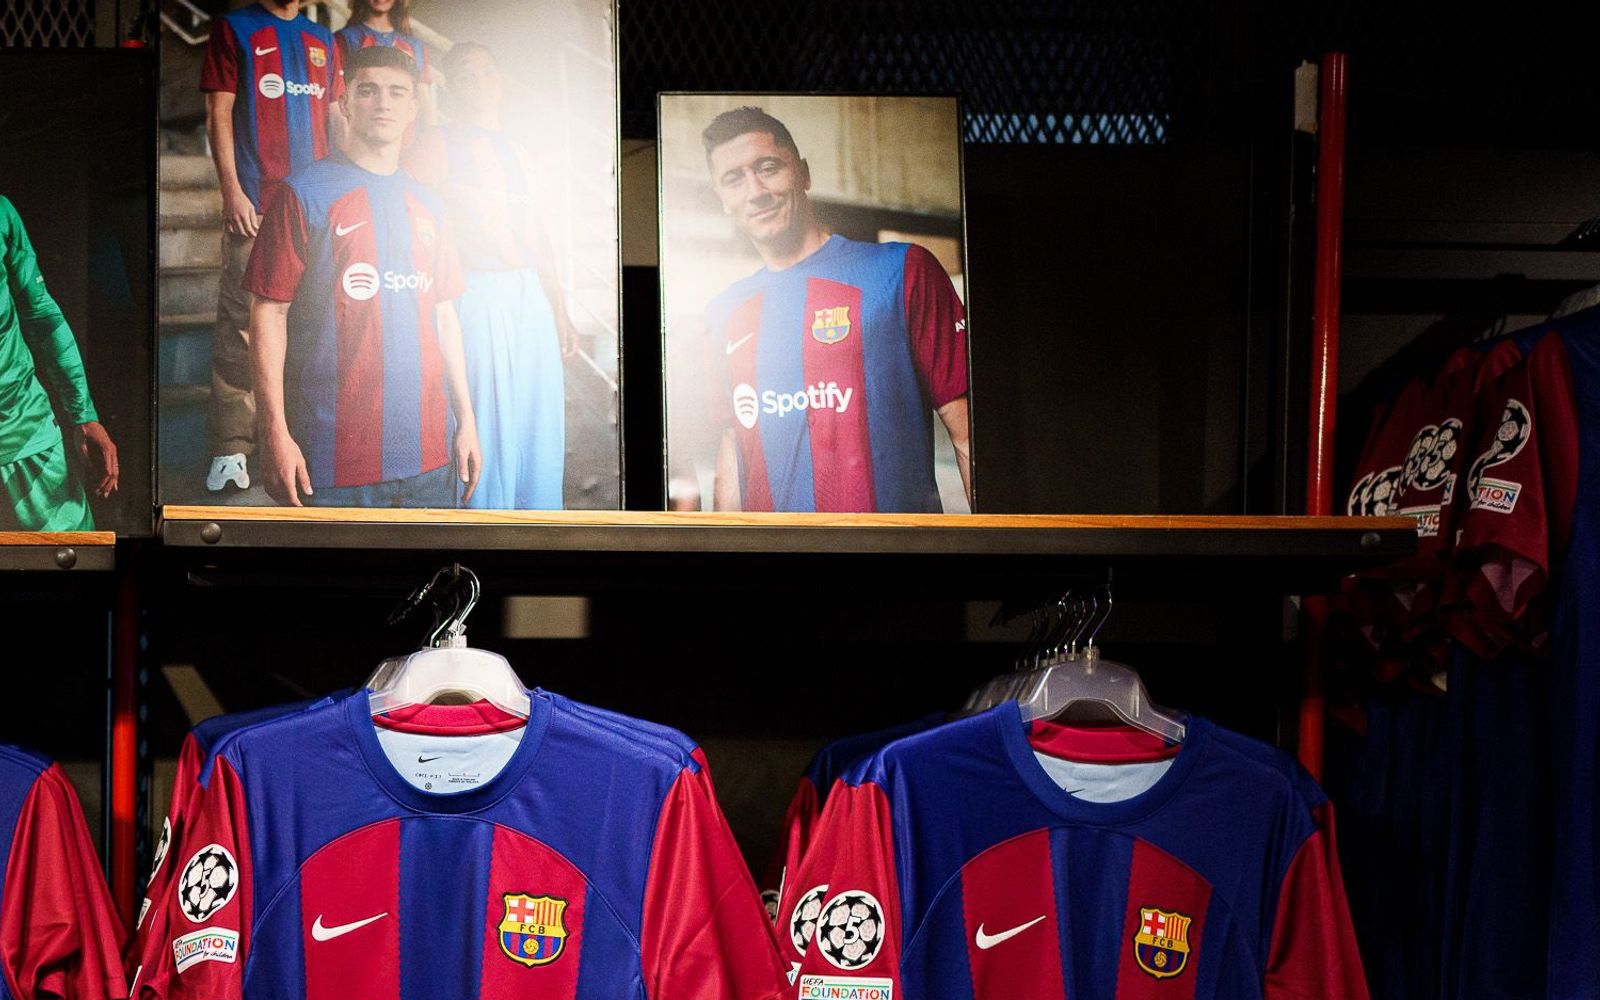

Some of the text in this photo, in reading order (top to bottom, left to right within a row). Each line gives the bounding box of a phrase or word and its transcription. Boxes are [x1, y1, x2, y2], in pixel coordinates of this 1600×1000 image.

[384, 271, 434, 293] Spoify
[762, 381, 853, 417] Spotify
[520, 923, 545, 935] FCB
[1152, 936, 1174, 949] FCB
[803, 977, 824, 985] UEFA
[802, 986, 890, 1000] FOUNDATION
